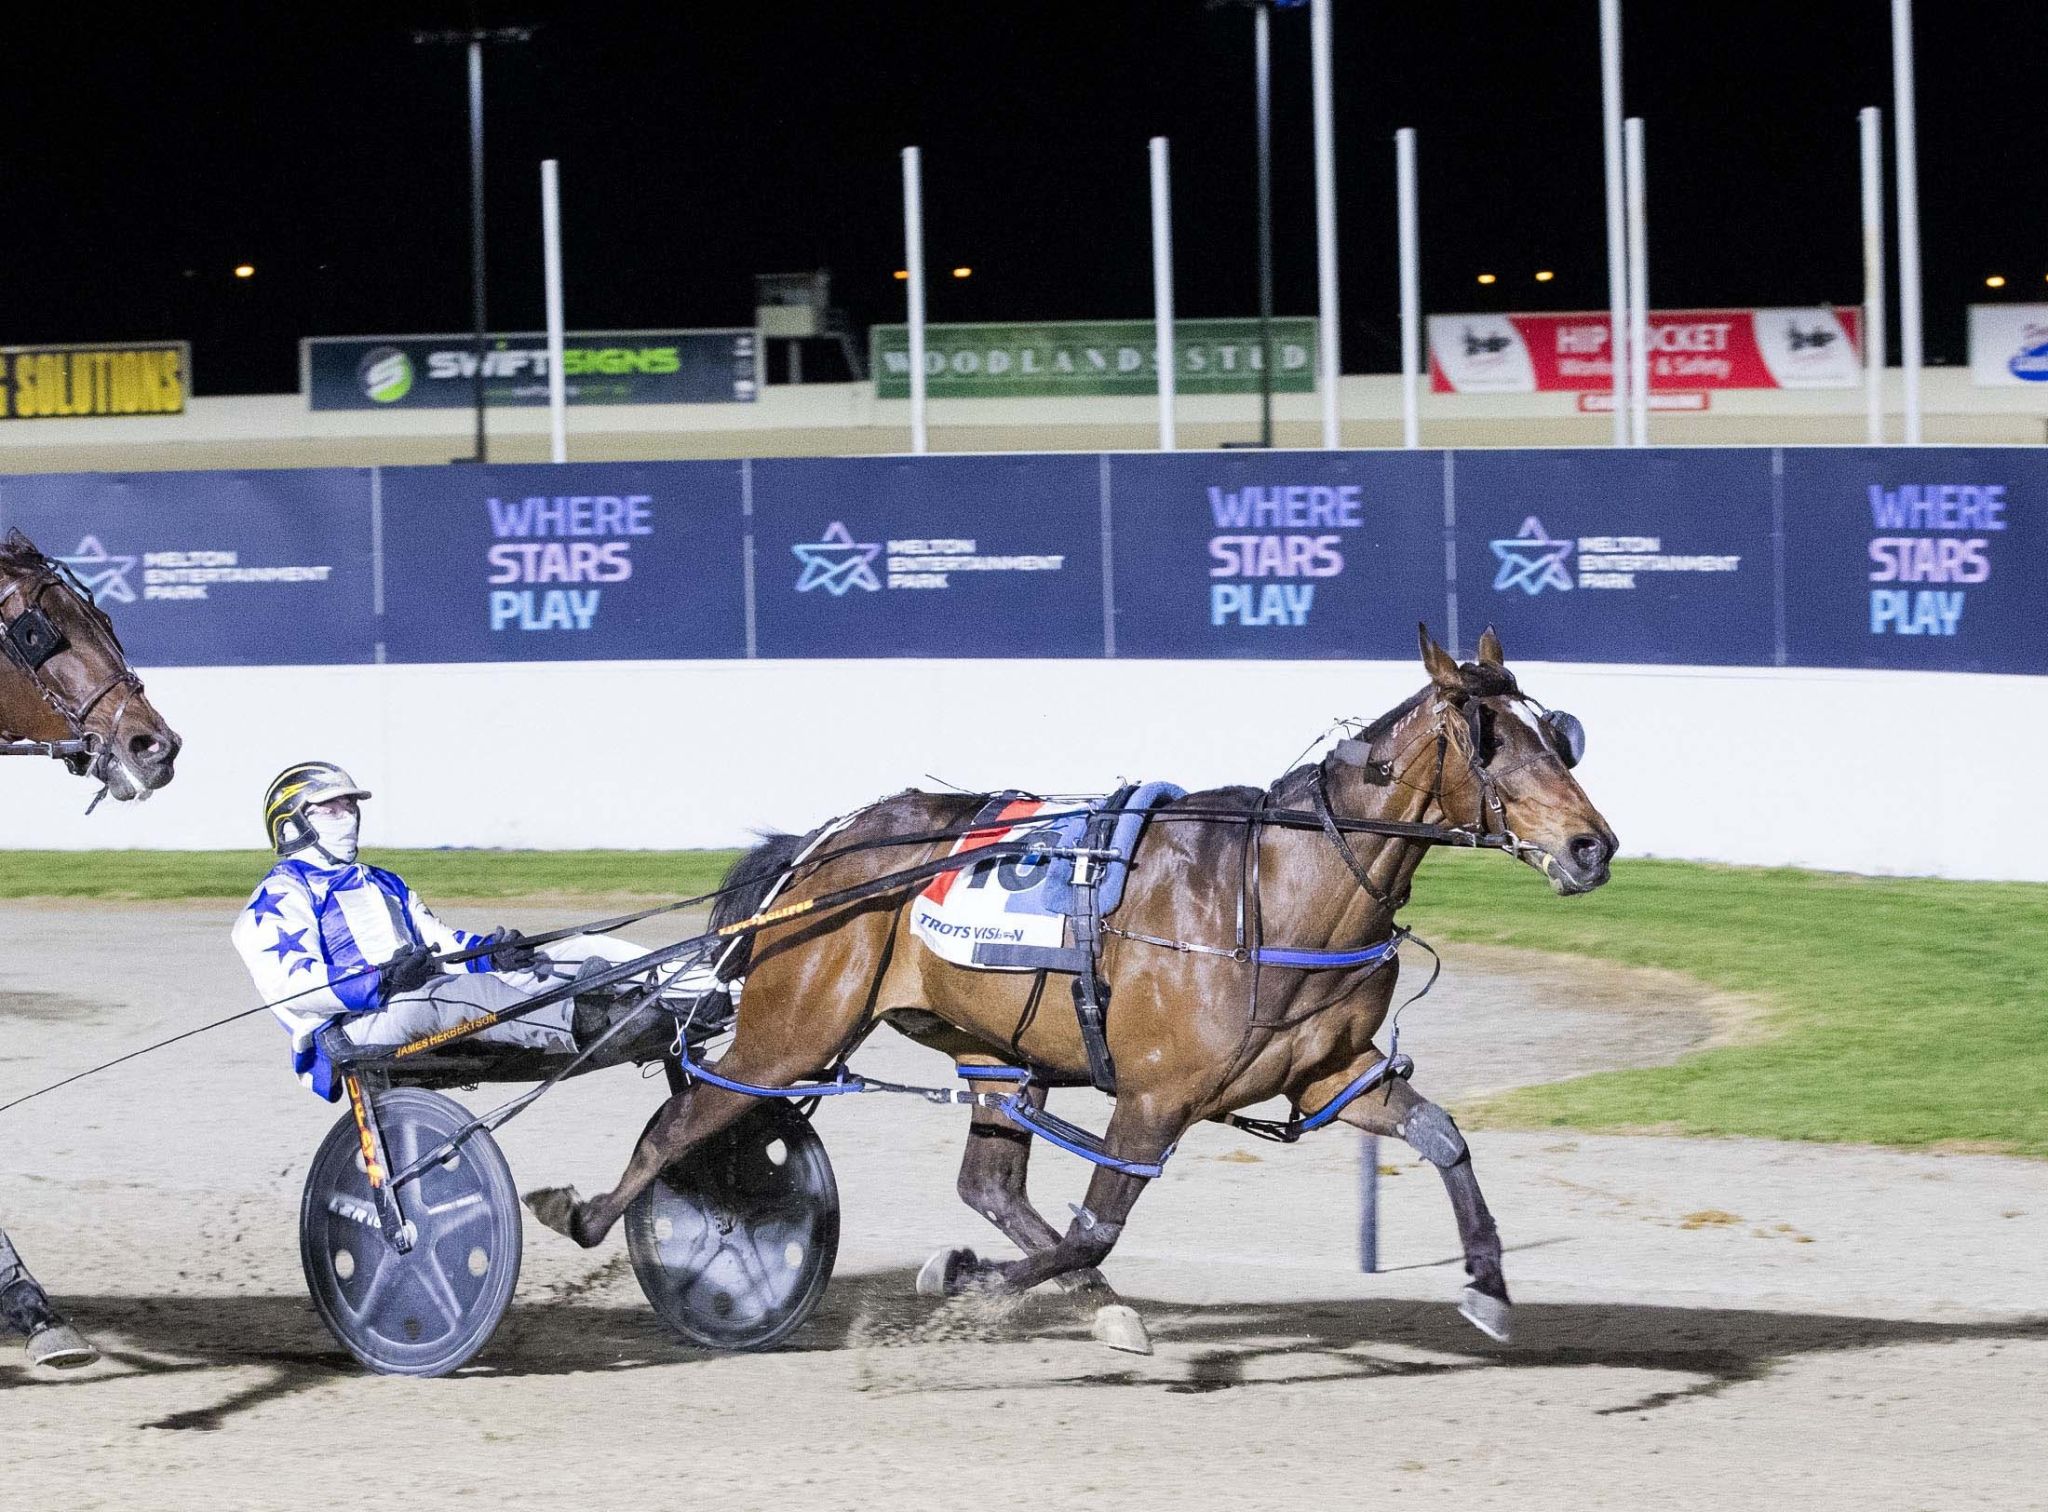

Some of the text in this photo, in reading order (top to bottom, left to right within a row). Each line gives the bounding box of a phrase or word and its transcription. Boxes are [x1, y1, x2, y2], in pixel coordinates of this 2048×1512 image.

[1556, 322, 1732, 353] HIP OCKET
[883, 346, 1160, 375] WOODLAND
[486, 496, 653, 536] WHERE
[1207, 485, 1364, 527] WHERE
[1867, 485, 2007, 529] WHERE
[143, 552, 237, 567] MELTON
[487, 542, 632, 583] STARS
[887, 539, 976, 553] MELTON
[1209, 535, 1344, 577] STARS
[1577, 537, 1660, 552] MELTON
[1869, 537, 1991, 582] STARS
[143, 585, 208, 600] PARK
[887, 573, 950, 588] PARK
[1578, 573, 1636, 588] PARK
[489, 589, 600, 630] PLAY
[1212, 584, 1315, 625] PLAY
[1871, 589, 1965, 634] PLAY
[920, 913, 970, 939] TROTS
[395, 1013, 497, 1058] JAMES HERBERTSON
